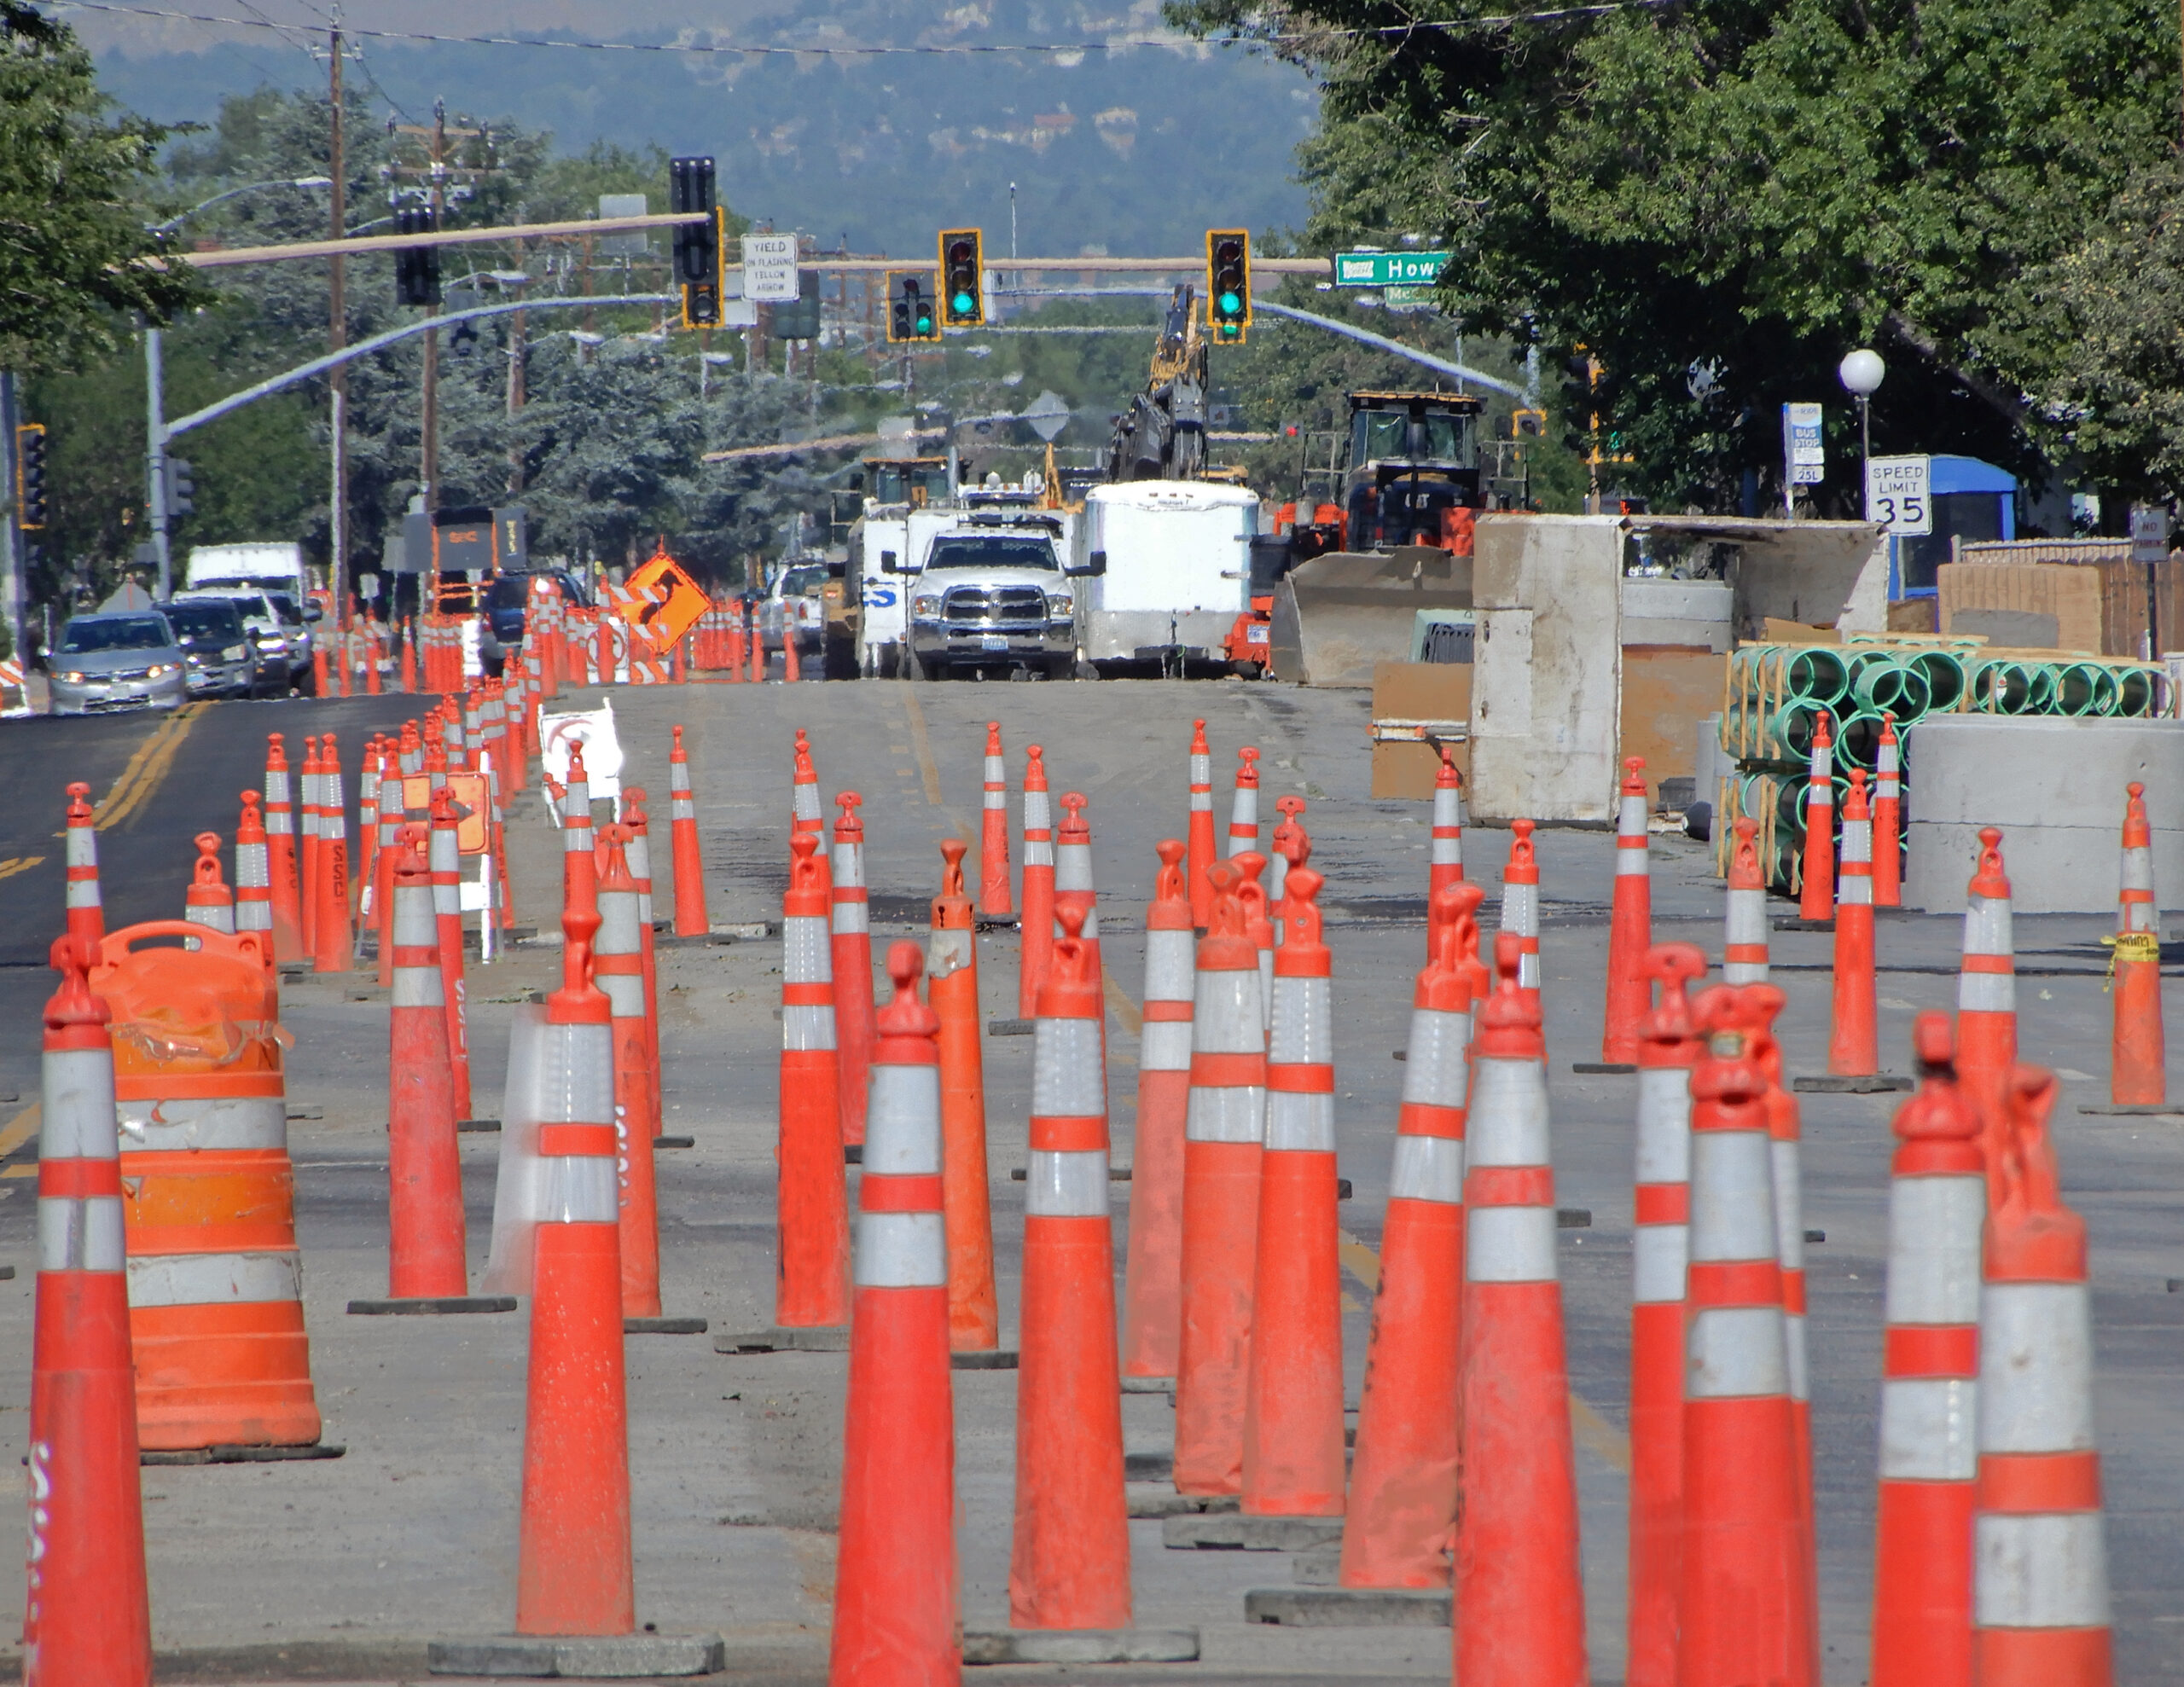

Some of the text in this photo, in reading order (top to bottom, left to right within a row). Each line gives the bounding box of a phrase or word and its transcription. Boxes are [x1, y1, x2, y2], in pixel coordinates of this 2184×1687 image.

[754, 241, 786, 252] YIELD
[1388, 258, 1435, 279] How
[755, 270, 785, 280] YELLOW
[1795, 428, 1816, 438] BUS
[1794, 438, 1820, 447] STOP
[1798, 470, 1818, 480] 25L
[1873, 467, 1924, 478] SPEED
[1879, 482, 1918, 494] LIMIT
[1875, 497, 1924, 525] 35
[2142, 522, 2158, 532] NO
